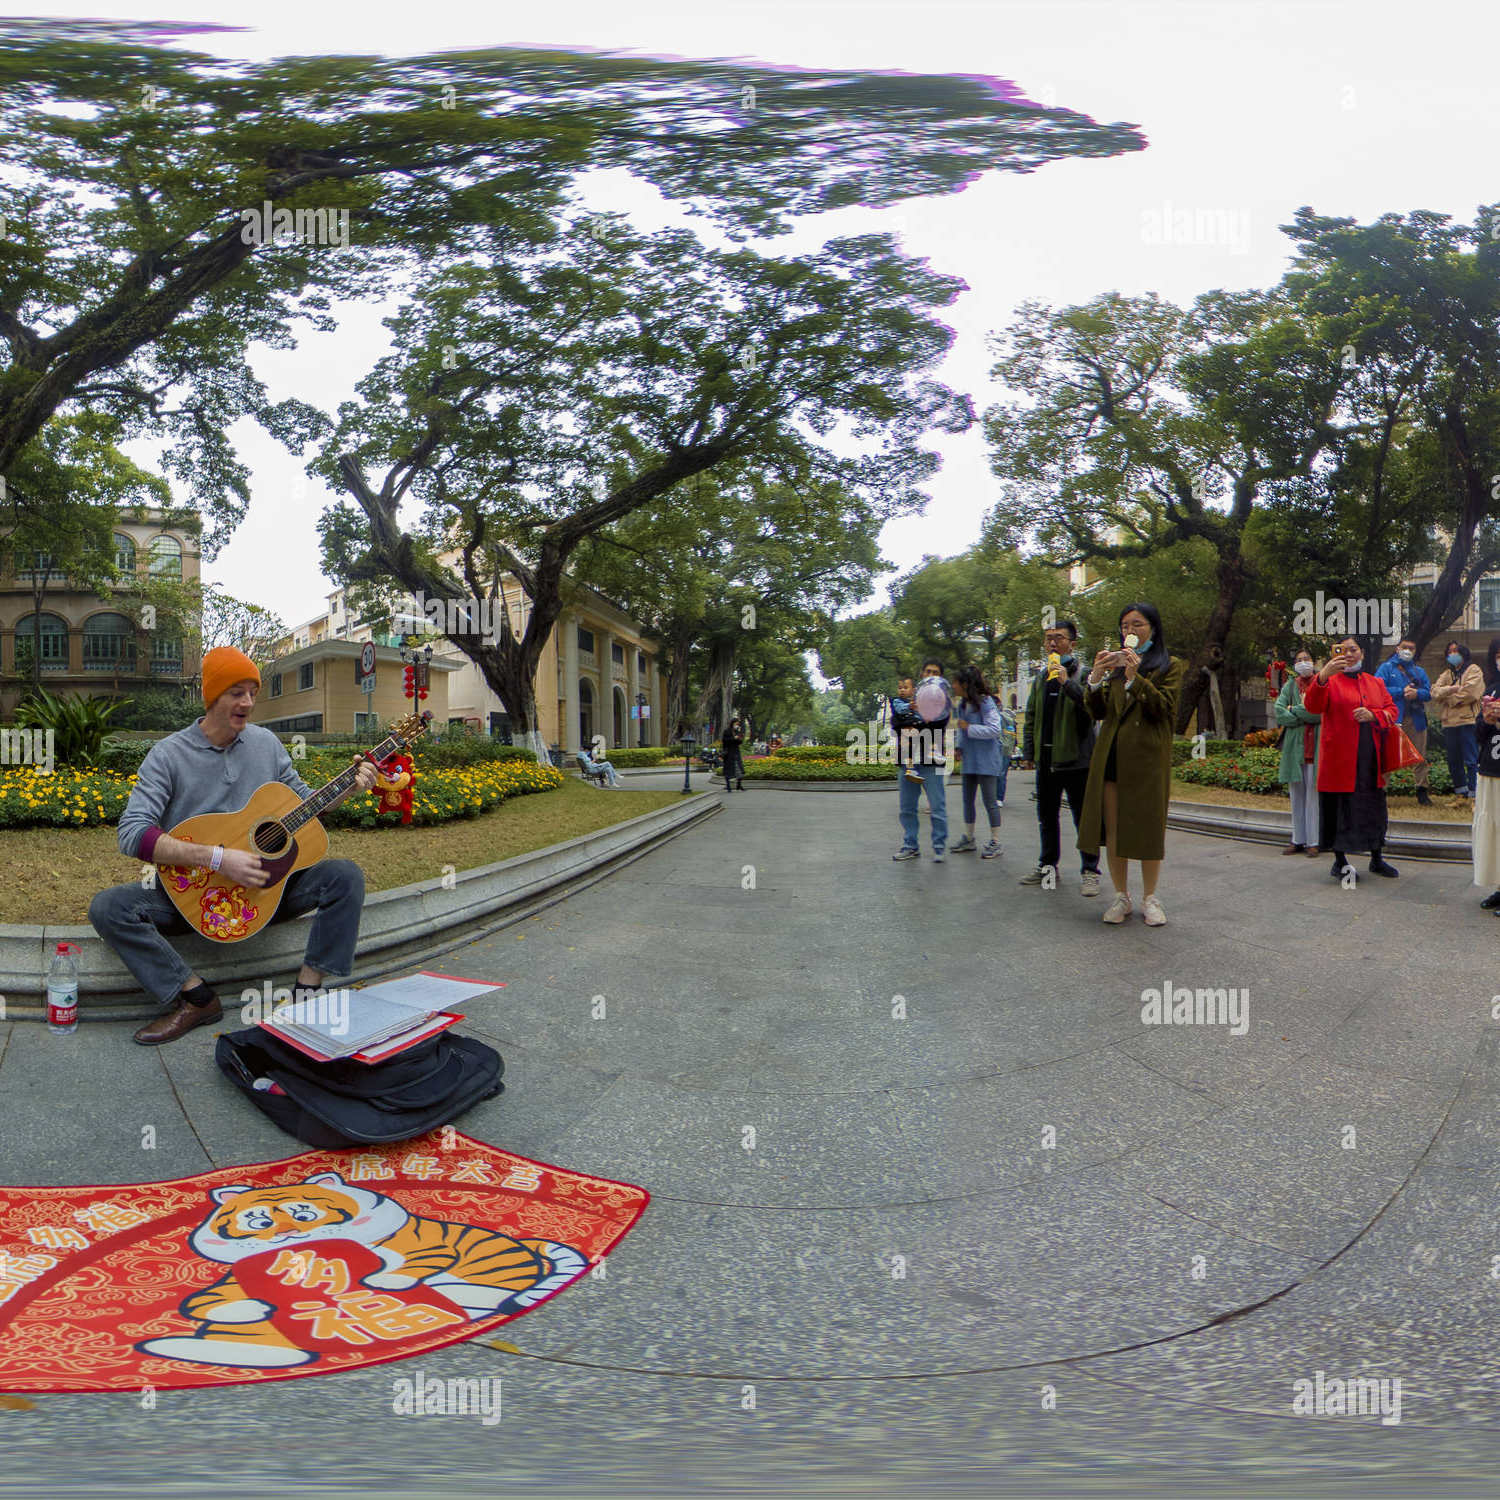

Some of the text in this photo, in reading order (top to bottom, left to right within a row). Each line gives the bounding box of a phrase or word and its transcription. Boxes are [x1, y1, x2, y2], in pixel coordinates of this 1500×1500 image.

[350, 1153, 543, 1192] 虎年大吉
[266, 1250, 466, 1345] 多福
